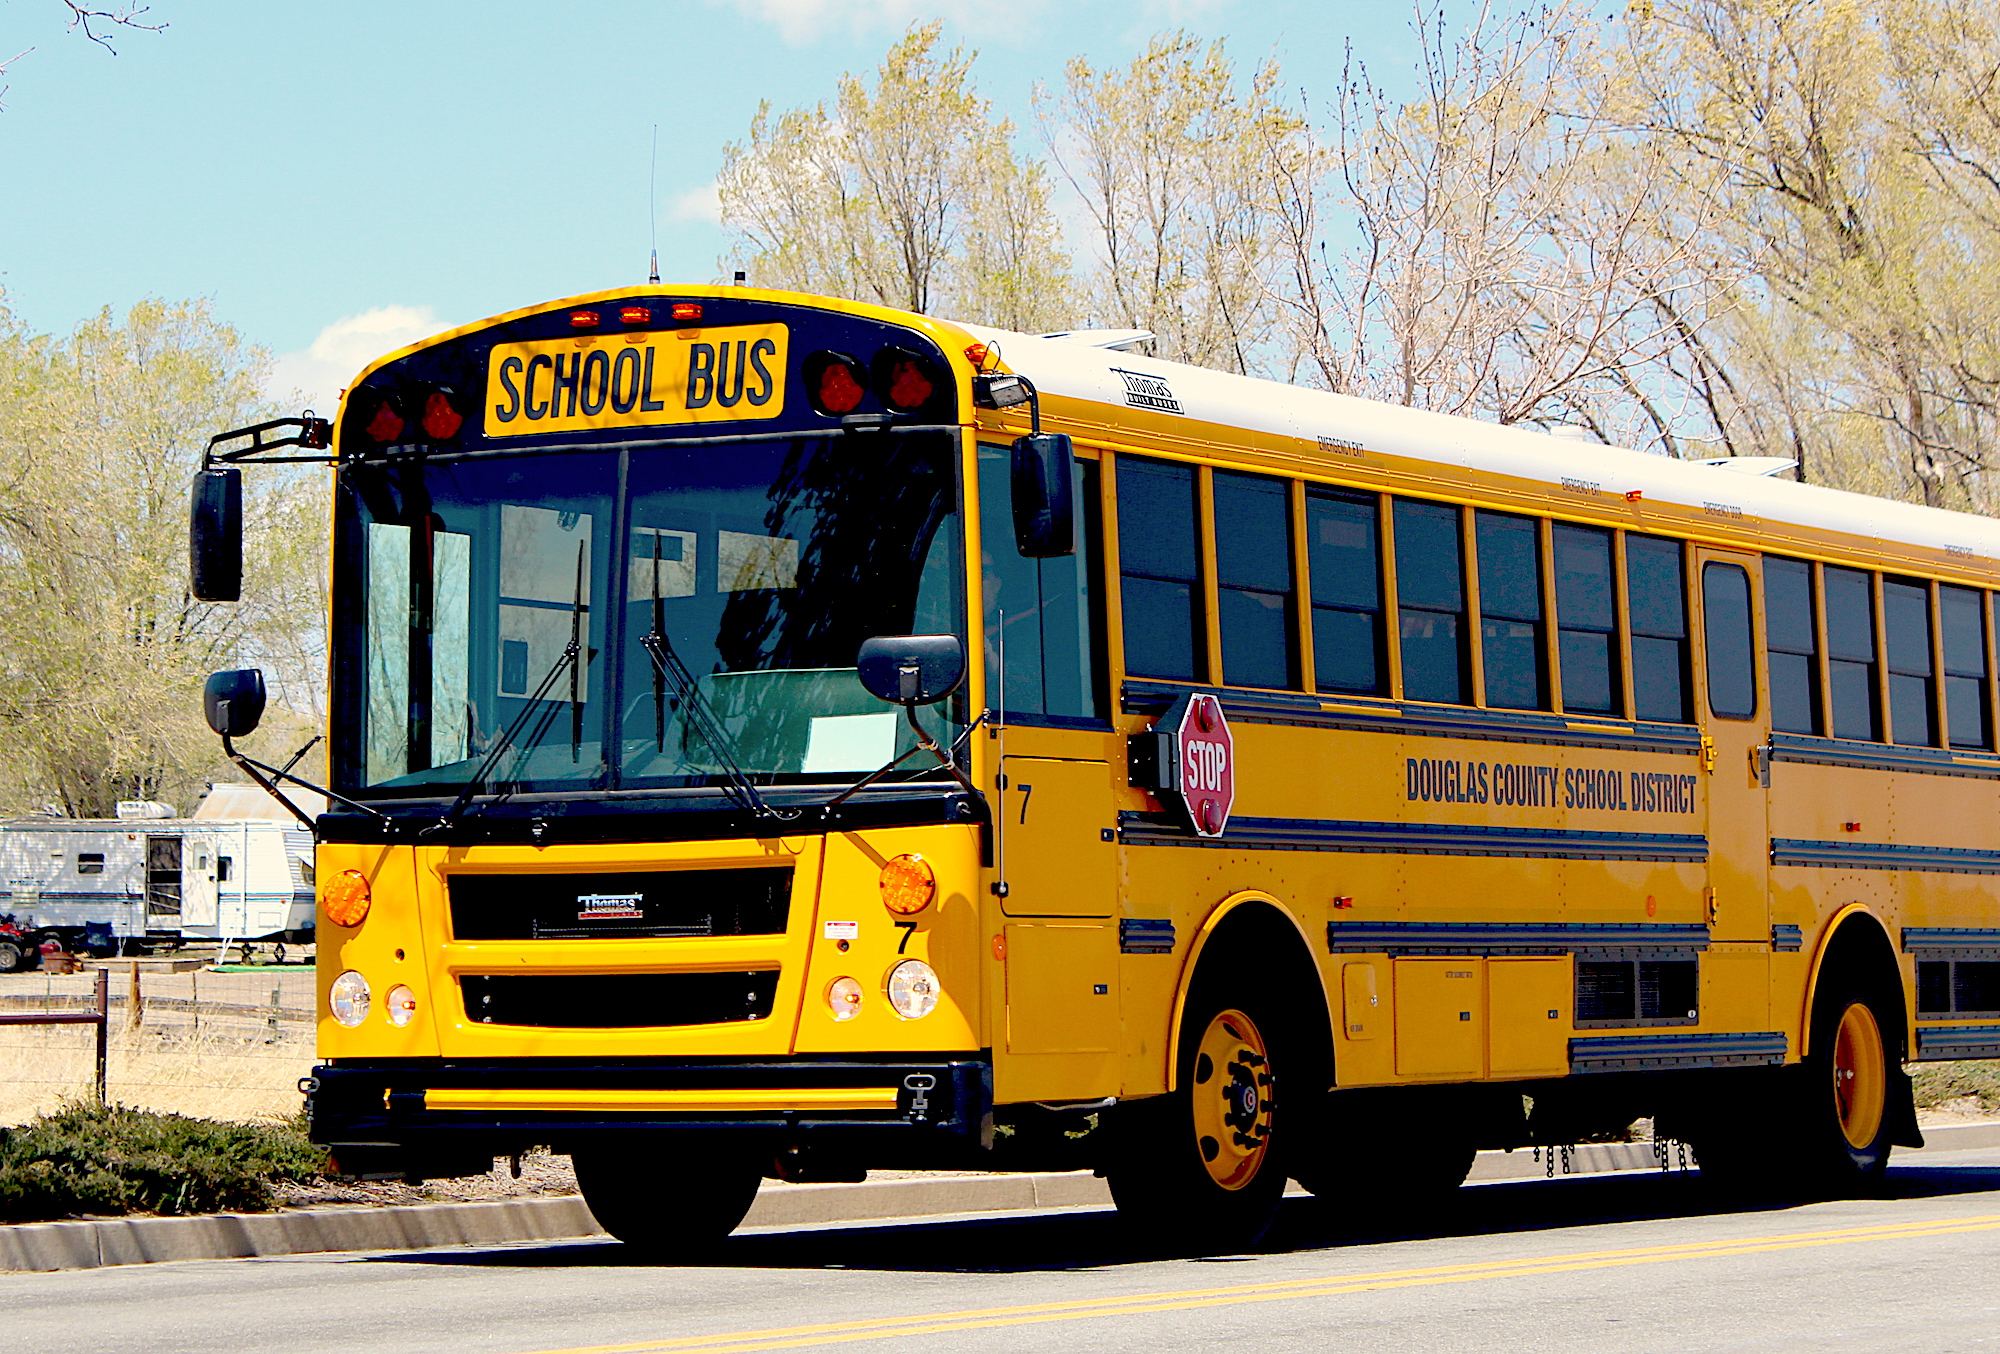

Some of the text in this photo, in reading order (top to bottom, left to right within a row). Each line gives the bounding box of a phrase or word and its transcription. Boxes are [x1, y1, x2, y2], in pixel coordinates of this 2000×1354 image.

[496, 338, 776, 422] SCHOOL BUS
[1317, 435, 1364, 458] EMERGENCY EXIT
[1187, 739, 1226, 792] STOP
[1406, 758, 1697, 814] DOUGLAS COUNTY SCHOOL DISTRICT
[1017, 784, 1032, 825] 7
[577, 893, 643, 912] Thomas
[894, 921, 917, 954] 7
